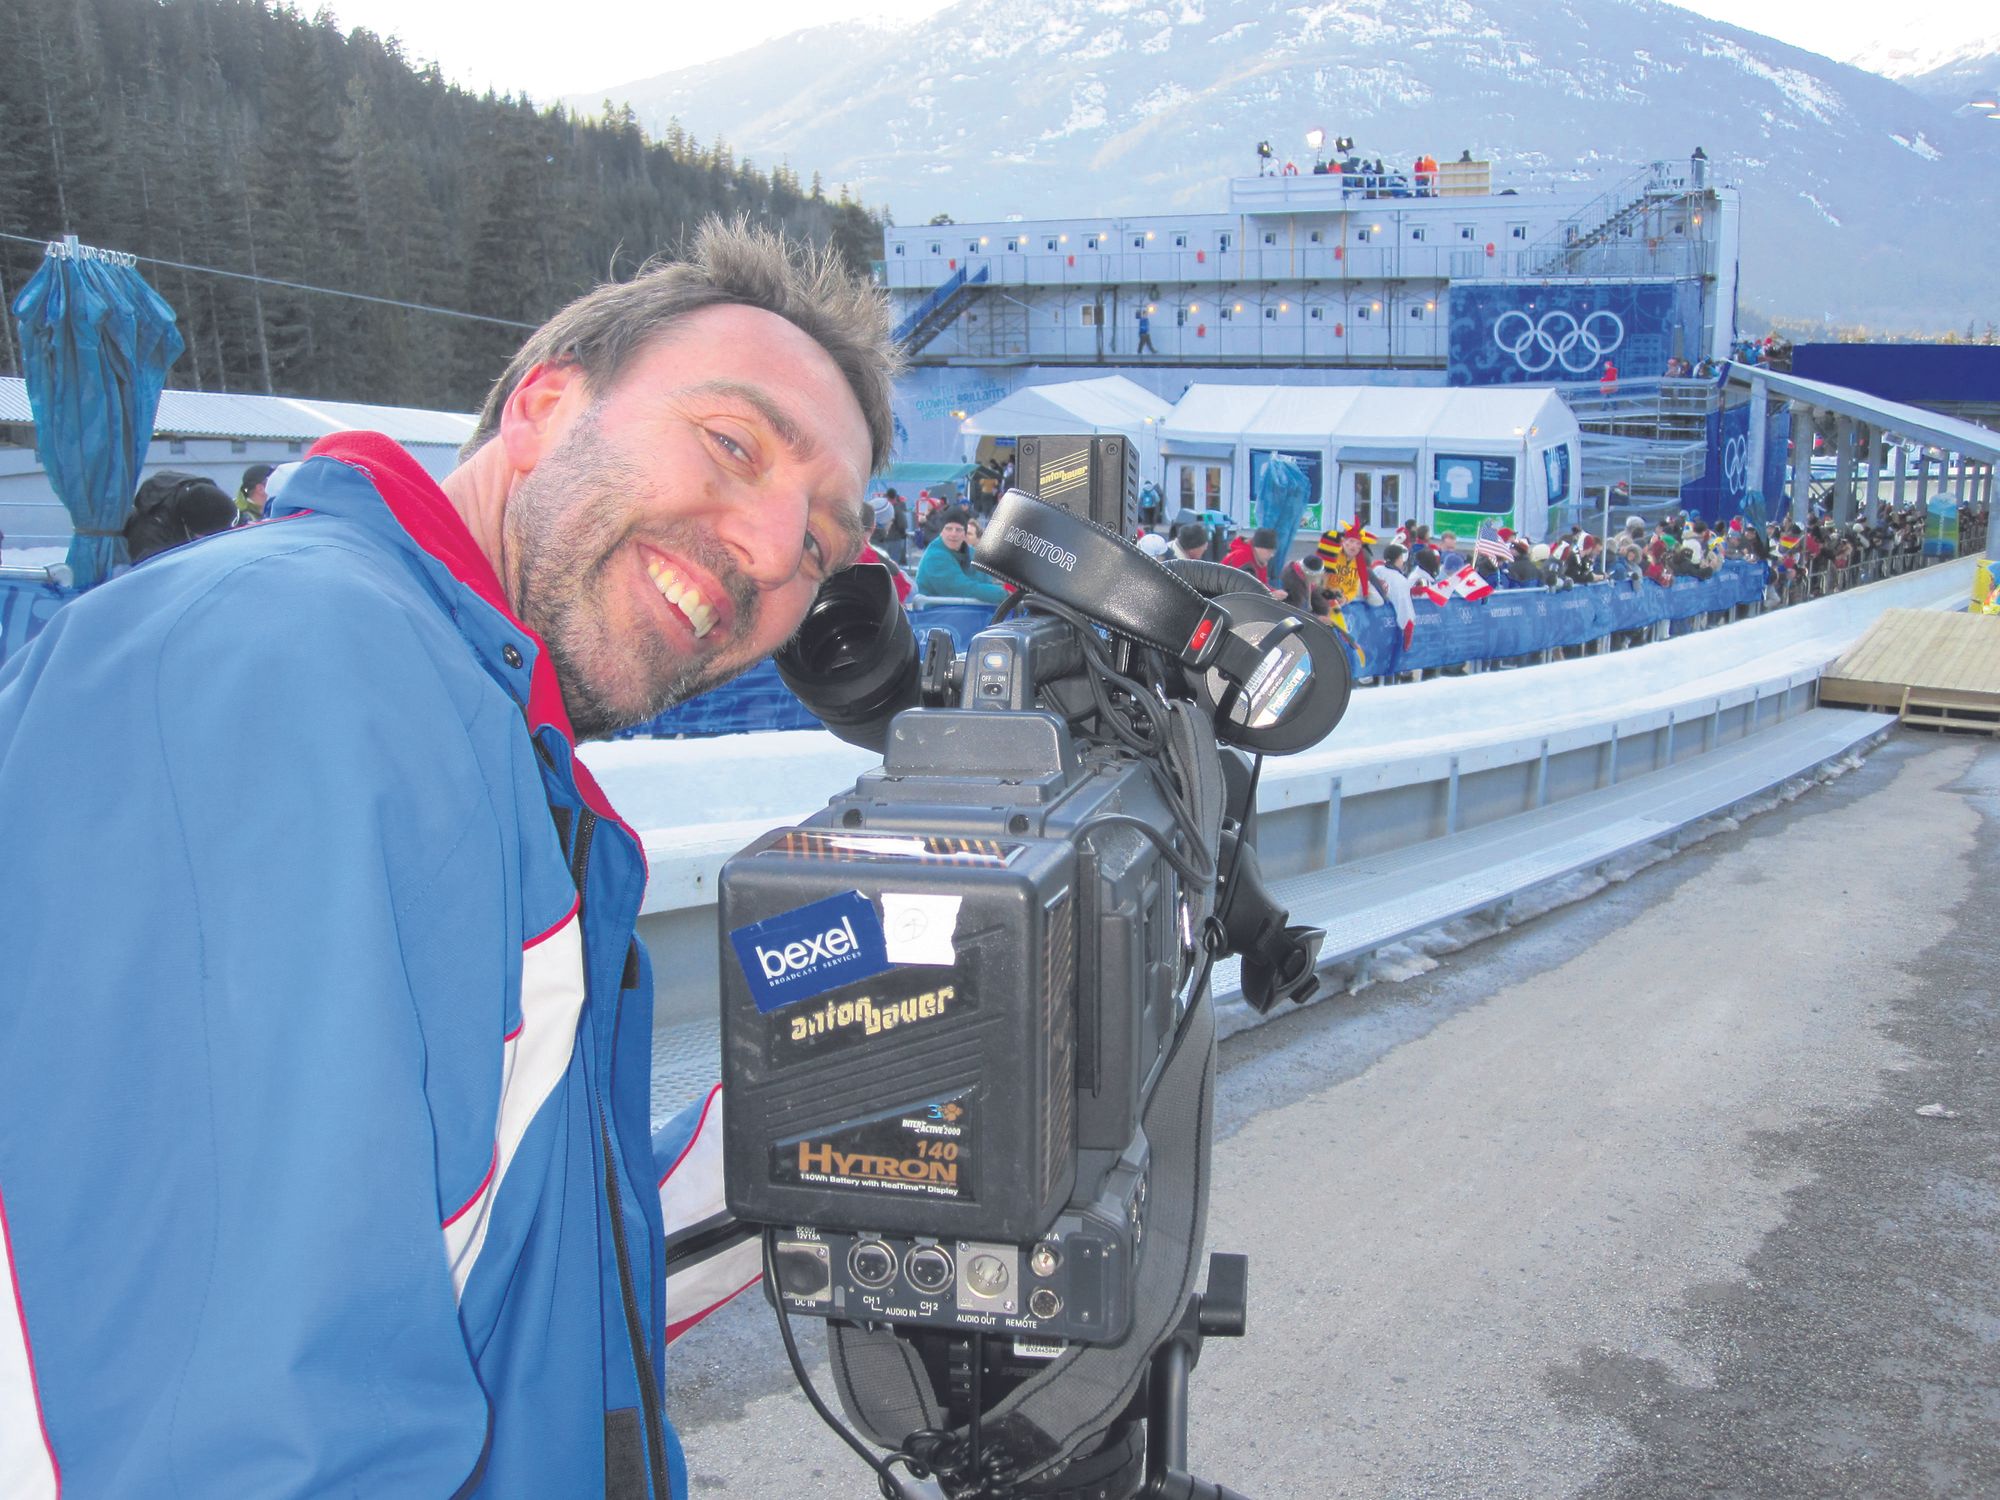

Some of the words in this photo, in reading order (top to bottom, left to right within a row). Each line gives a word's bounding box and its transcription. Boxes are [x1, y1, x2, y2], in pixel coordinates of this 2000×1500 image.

[1004, 526, 1077, 572] MONITOR
[755, 915, 859, 980] bexel
[769, 966, 818, 988] BROADCAST
[822, 951, 862, 969] SERVICES
[917, 1140, 958, 1161] 140
[798, 1141, 958, 1182] HYTRON
[829, 1175, 861, 1187] Battery
[861, 1178, 880, 1188] with
[927, 1186, 959, 1196] Display
[862, 1295, 875, 1304] CH
[920, 1301, 932, 1310] CH
[933, 1303, 939, 1311] 2
[885, 1307, 908, 1317] AUDIO
[908, 1309, 917, 1318] IN
[956, 1314, 980, 1324] AUDIO
[980, 1316, 997, 1325] OUT
[1005, 1318, 1038, 1329] REMOTE
